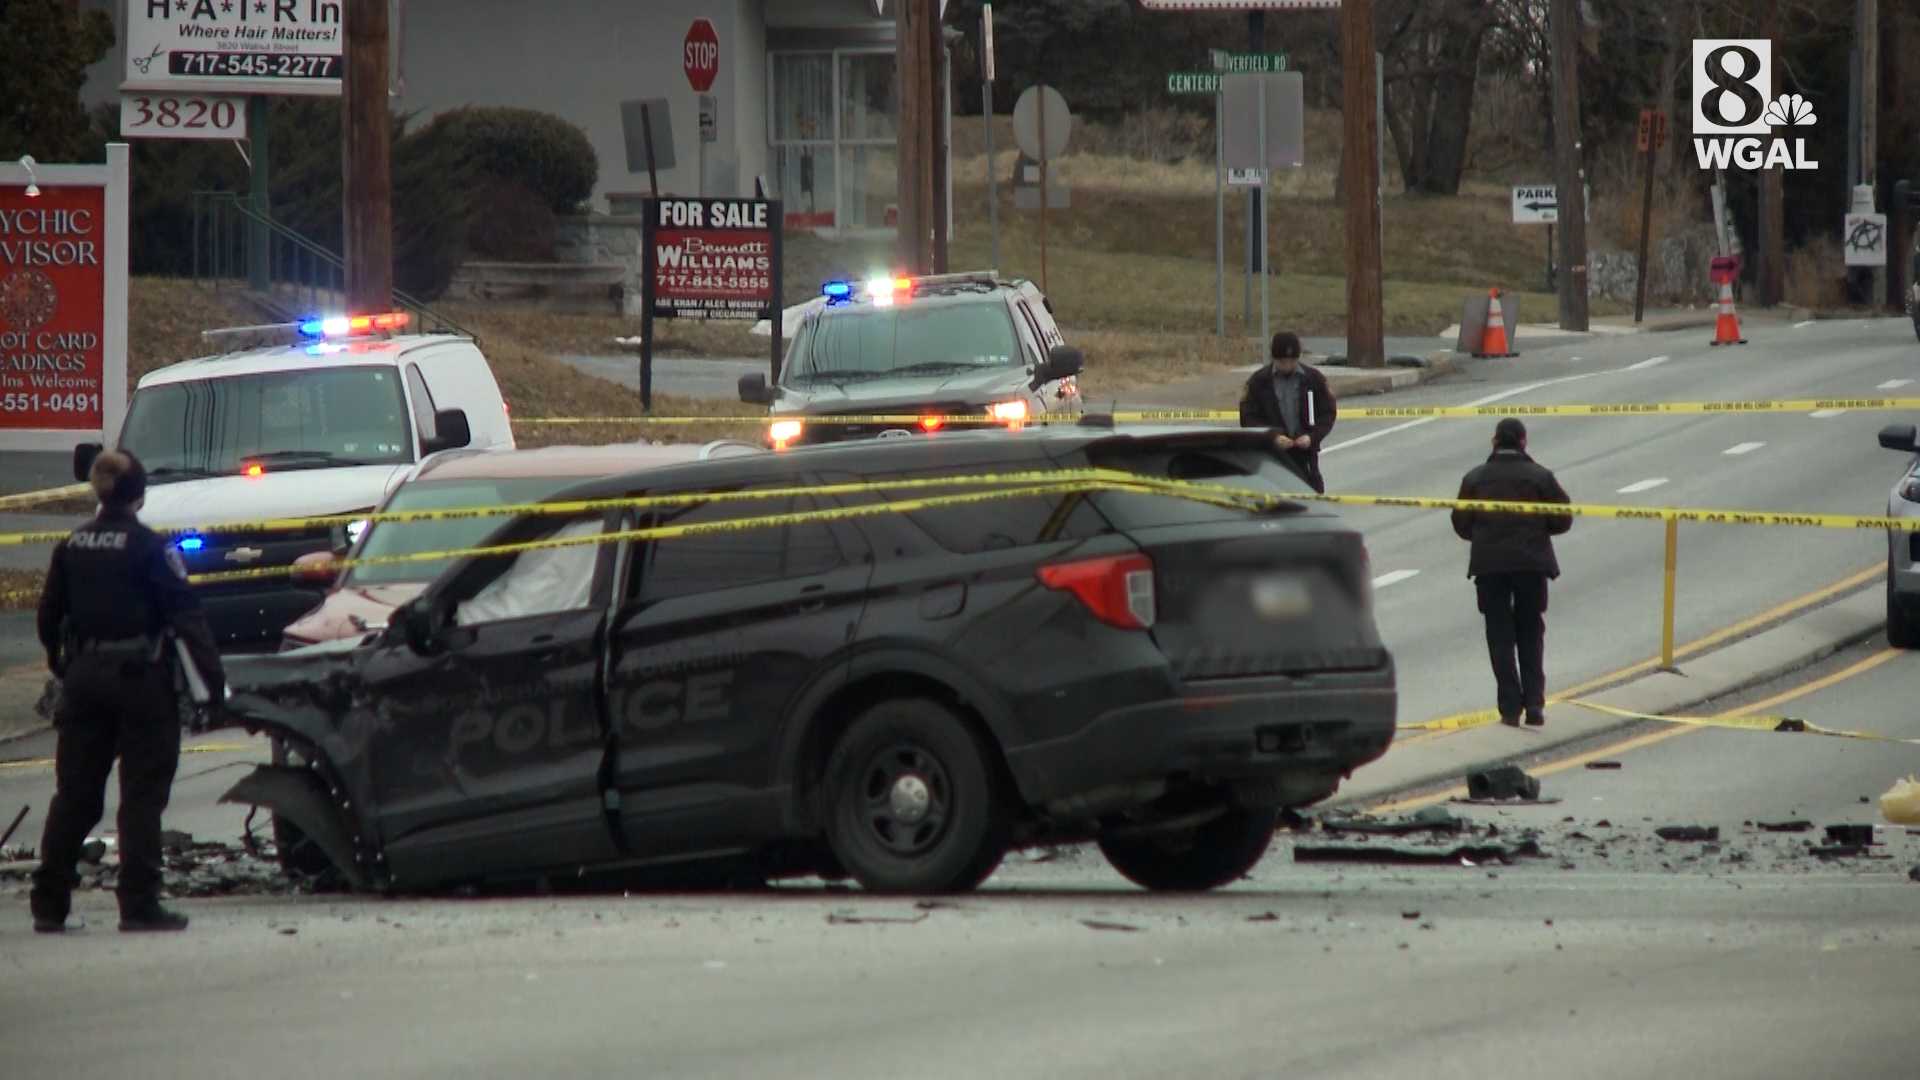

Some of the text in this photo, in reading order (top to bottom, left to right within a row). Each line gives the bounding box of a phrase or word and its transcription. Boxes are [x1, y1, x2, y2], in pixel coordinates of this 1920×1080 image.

[179, 24, 337, 41] Where Hair Matters!
[182, 53, 332, 76] 717-545-2277
[685, 42, 717, 70] STOP
[1229, 55, 1287, 72] VERFIELD RD
[1168, 74, 1223, 92] CENTERFI
[130, 97, 236, 129] 3820
[1517, 188, 1554, 200] PARK
[0, 209, 93, 234] YCHIC
[660, 201, 767, 228] FOR SALE
[1, 240, 97, 265] VISOR
[682, 237, 768, 254] Bennett
[656, 245, 769, 270] WILLIAMS
[657, 275, 769, 289] 717-843-5555
[36, 332, 97, 351] CARD
[0, 353, 86, 372] ADINGS
[30, 374, 97, 388] Welcome
[0, 392, 98, 412] -551-0491
[67, 531, 129, 549] POLICE
[446, 669, 735, 759] POLICE
